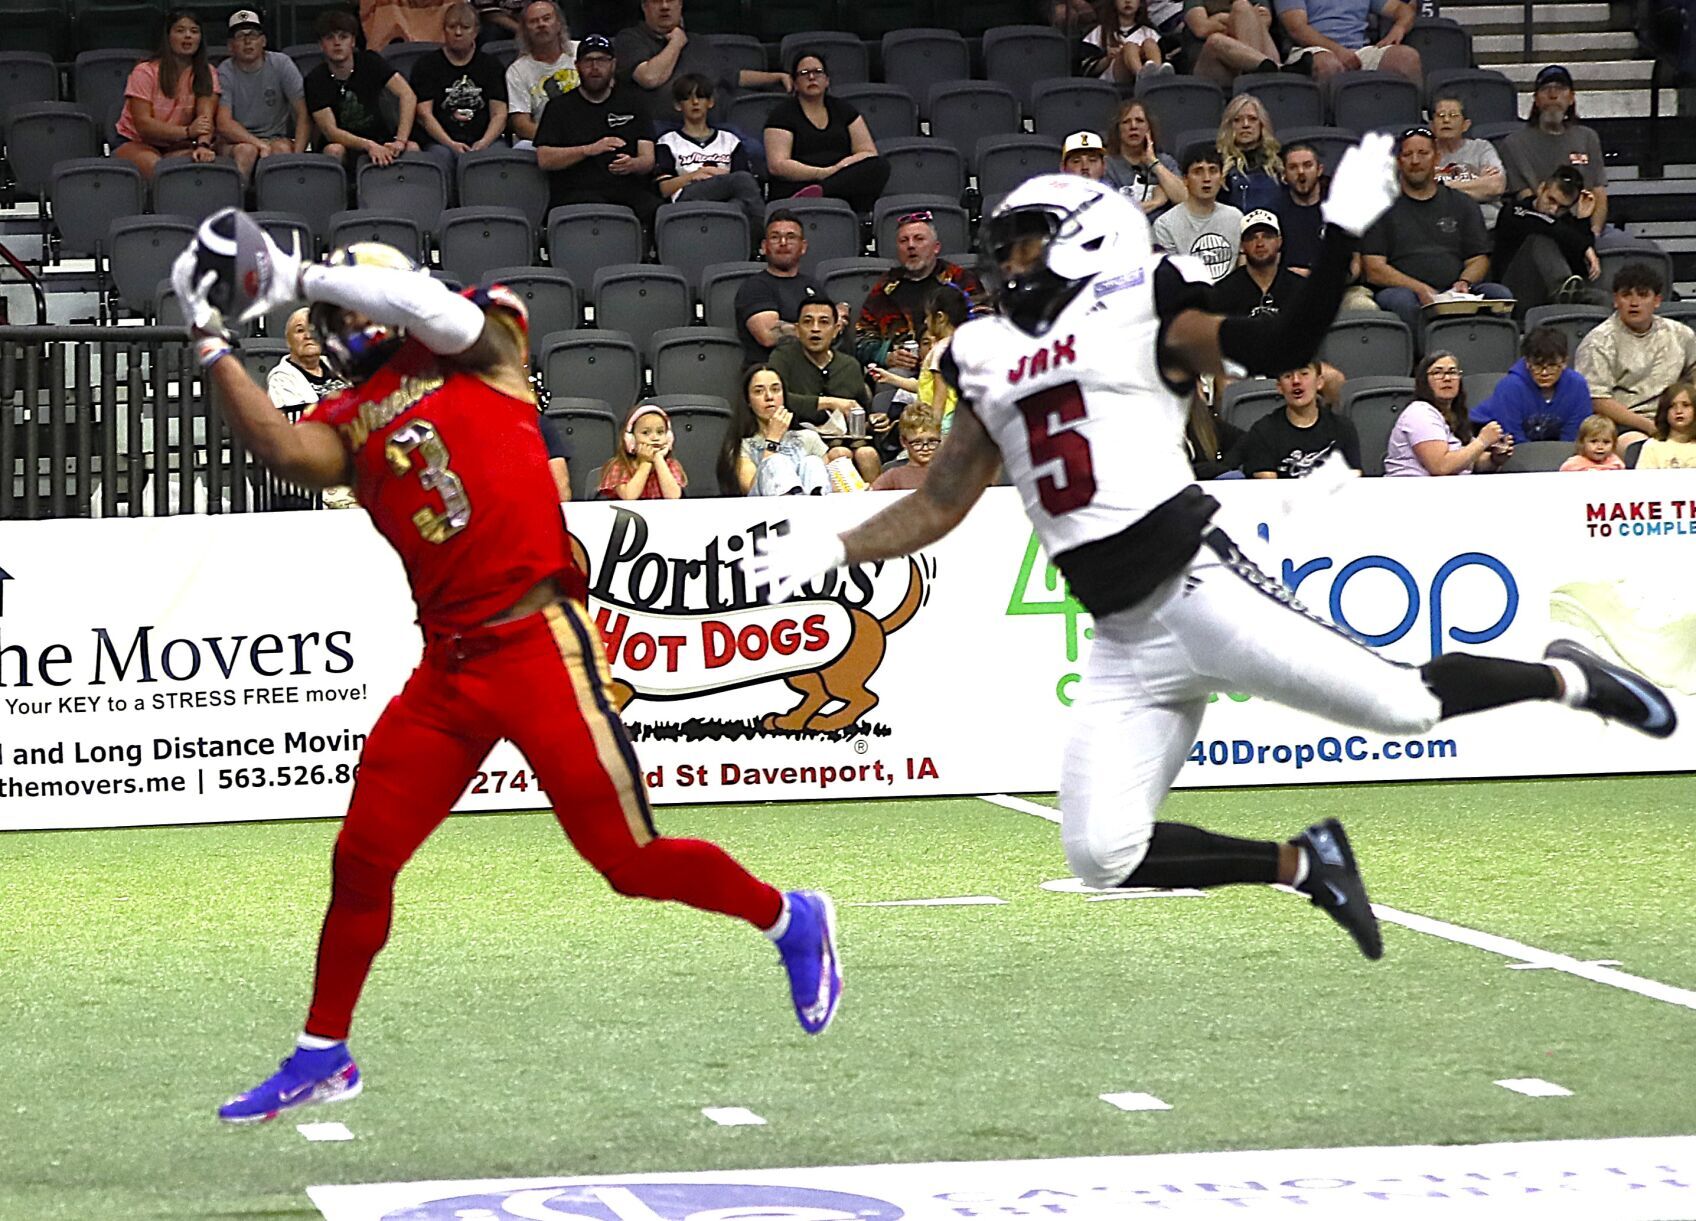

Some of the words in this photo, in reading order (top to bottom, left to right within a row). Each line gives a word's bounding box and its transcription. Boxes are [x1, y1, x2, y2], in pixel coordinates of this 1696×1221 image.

[1008, 334, 1076, 385] JAX
[1015, 379, 1098, 518] 5
[385, 418, 473, 545] 3
[1586, 501, 1662, 522] MAKE
[1586, 523, 1612, 538] TO
[88, 625, 354, 685] Movers
[595, 606, 687, 673] HOT
[701, 614, 830, 669] DOGS
[5, 698, 52, 715] Your
[58, 696, 101, 713] KEY
[107, 696, 127, 712] to
[134, 698, 145, 711] a
[152, 690, 236, 709] STRESS
[243, 686, 299, 705] FREE
[306, 683, 367, 702] move!
[13, 741, 64, 766] and
[75, 741, 142, 767] Long
[153, 735, 275, 761] Distance
[284, 728, 367, 754] Movin
[1187, 735, 1457, 769] 40DropQC.com
[675, 764, 709, 787] St
[720, 758, 894, 788] Davenport,
[906, 756, 940, 781] IA
